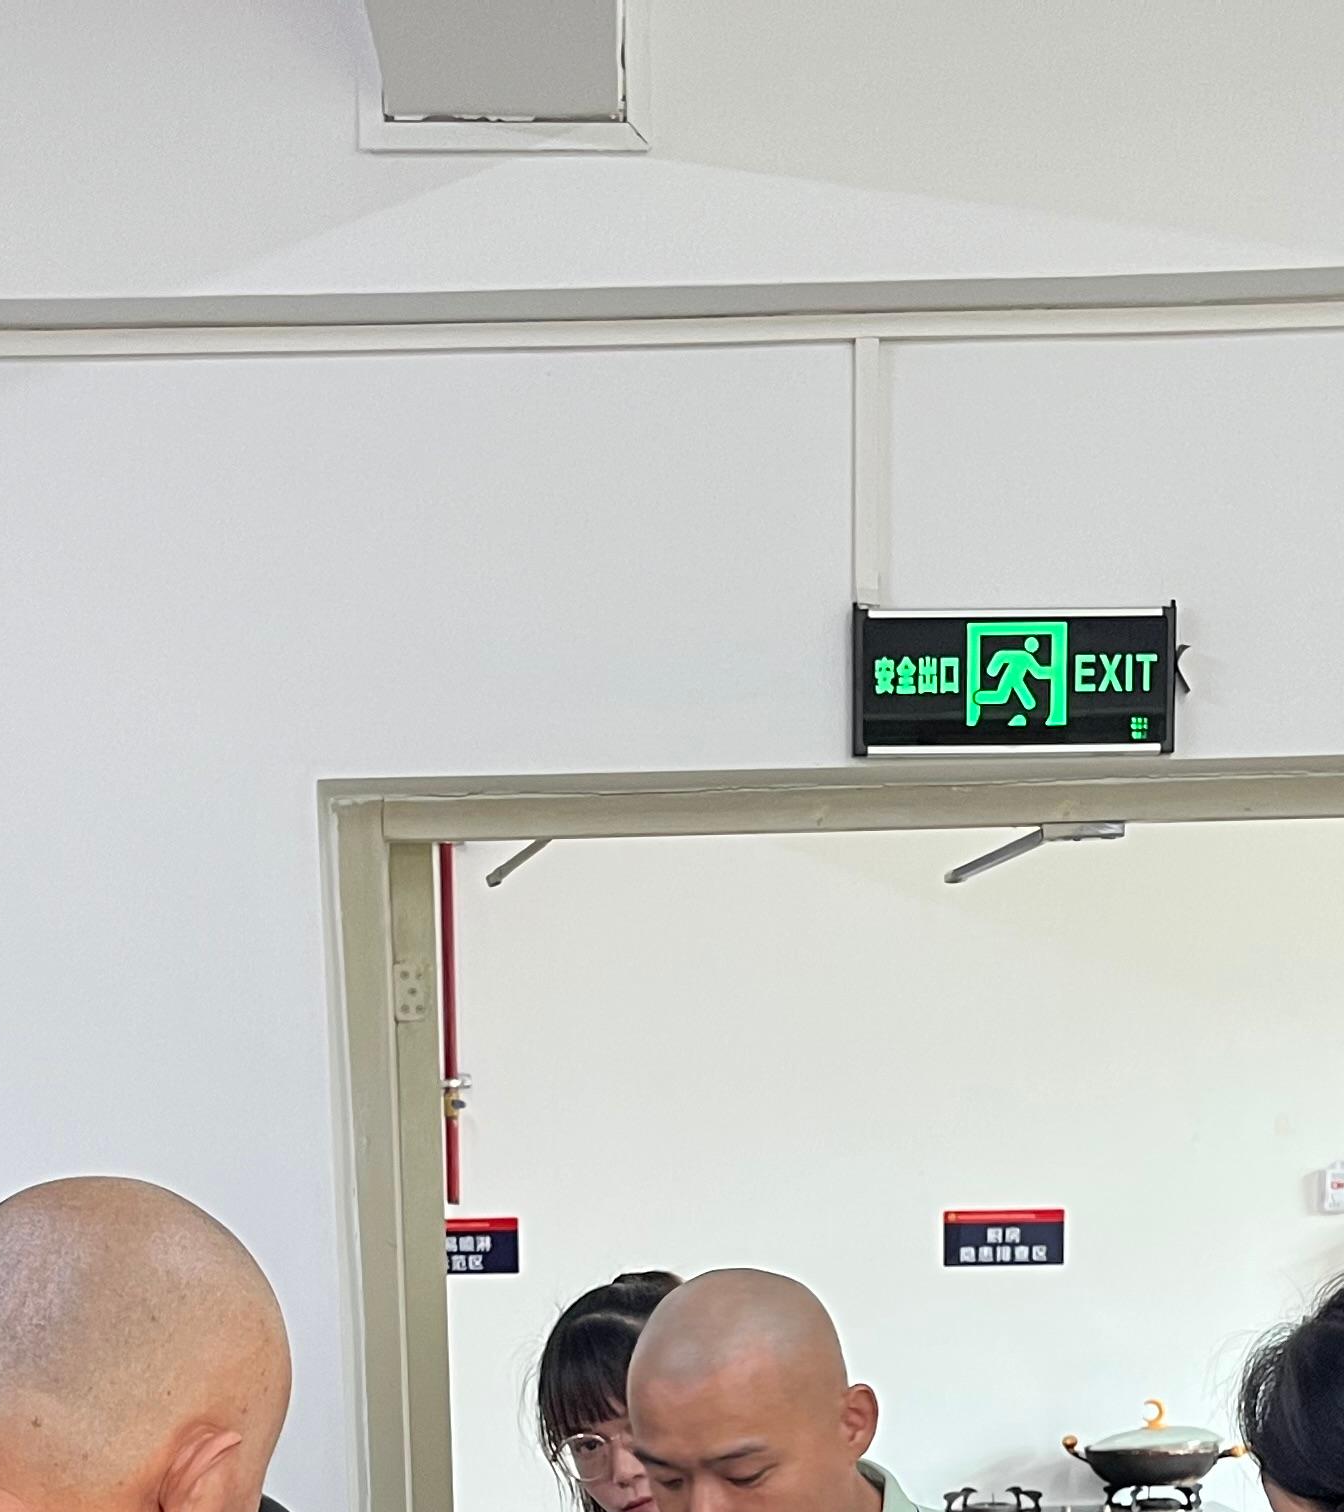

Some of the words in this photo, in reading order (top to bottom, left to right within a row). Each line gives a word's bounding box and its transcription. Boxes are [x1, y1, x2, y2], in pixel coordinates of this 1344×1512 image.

[874, 655, 960, 695] 安全出口
[1074, 653, 1158, 692] EXIT
